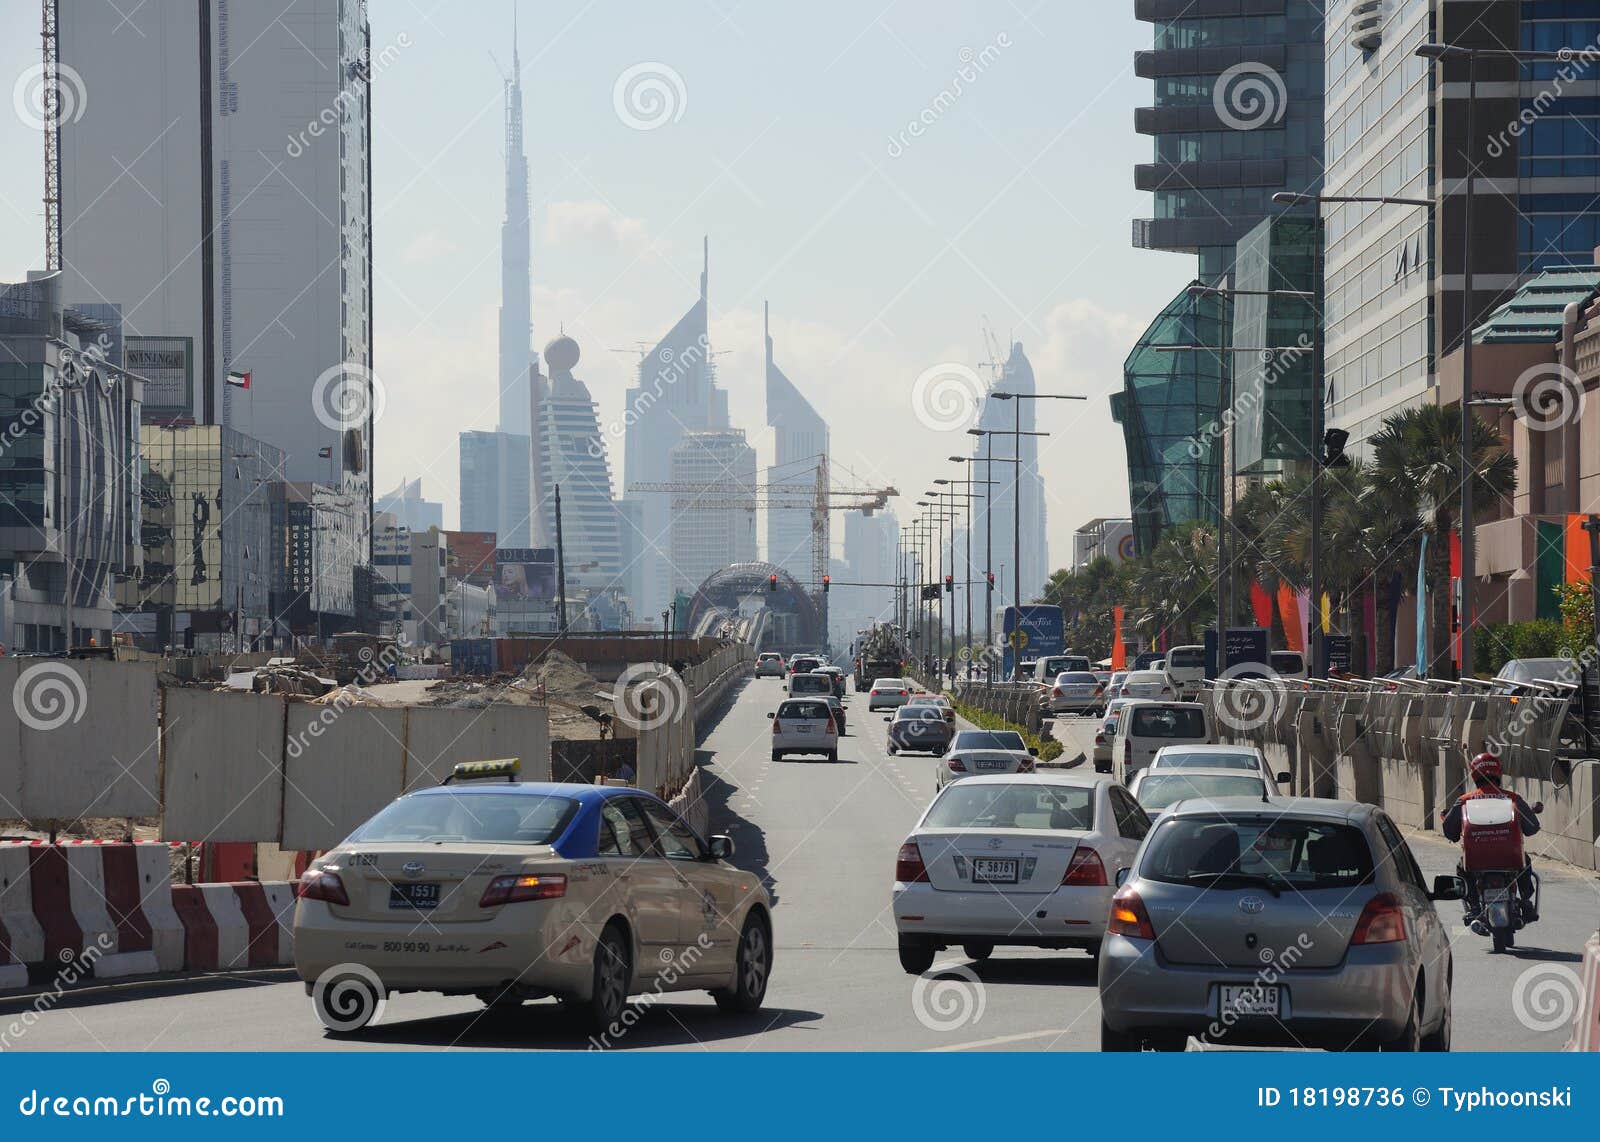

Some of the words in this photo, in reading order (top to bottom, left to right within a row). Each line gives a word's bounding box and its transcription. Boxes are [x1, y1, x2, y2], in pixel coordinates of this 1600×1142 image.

[978, 862, 984, 871] F
[410, 885, 435, 897] 1551
[383, 941, 402, 952] 800
[403, 942, 416, 952] 90
[417, 942, 431, 952] 90
